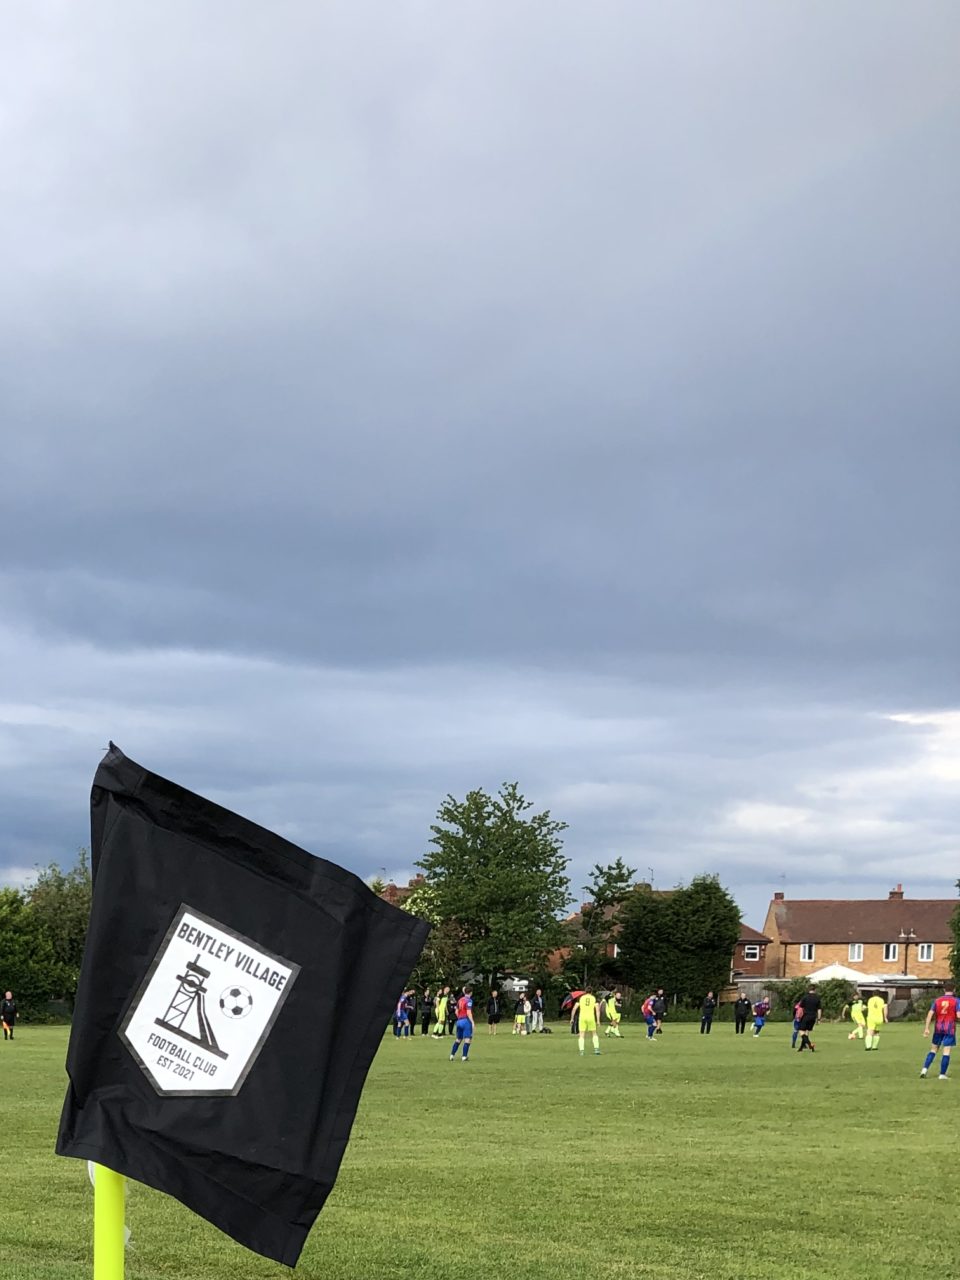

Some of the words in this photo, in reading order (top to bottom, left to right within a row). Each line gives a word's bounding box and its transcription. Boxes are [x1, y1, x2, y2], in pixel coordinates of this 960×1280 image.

[177, 923, 234, 962] BENTLEY
[235, 951, 286, 991] VILLAGE
[941, 1001, 949, 1014] 2
[147, 1033, 193, 1064] FOOTBALL
[193, 1056, 218, 1076] CLUB
[156, 1056, 174, 1069] EST
[173, 1064, 195, 1080] 2021
